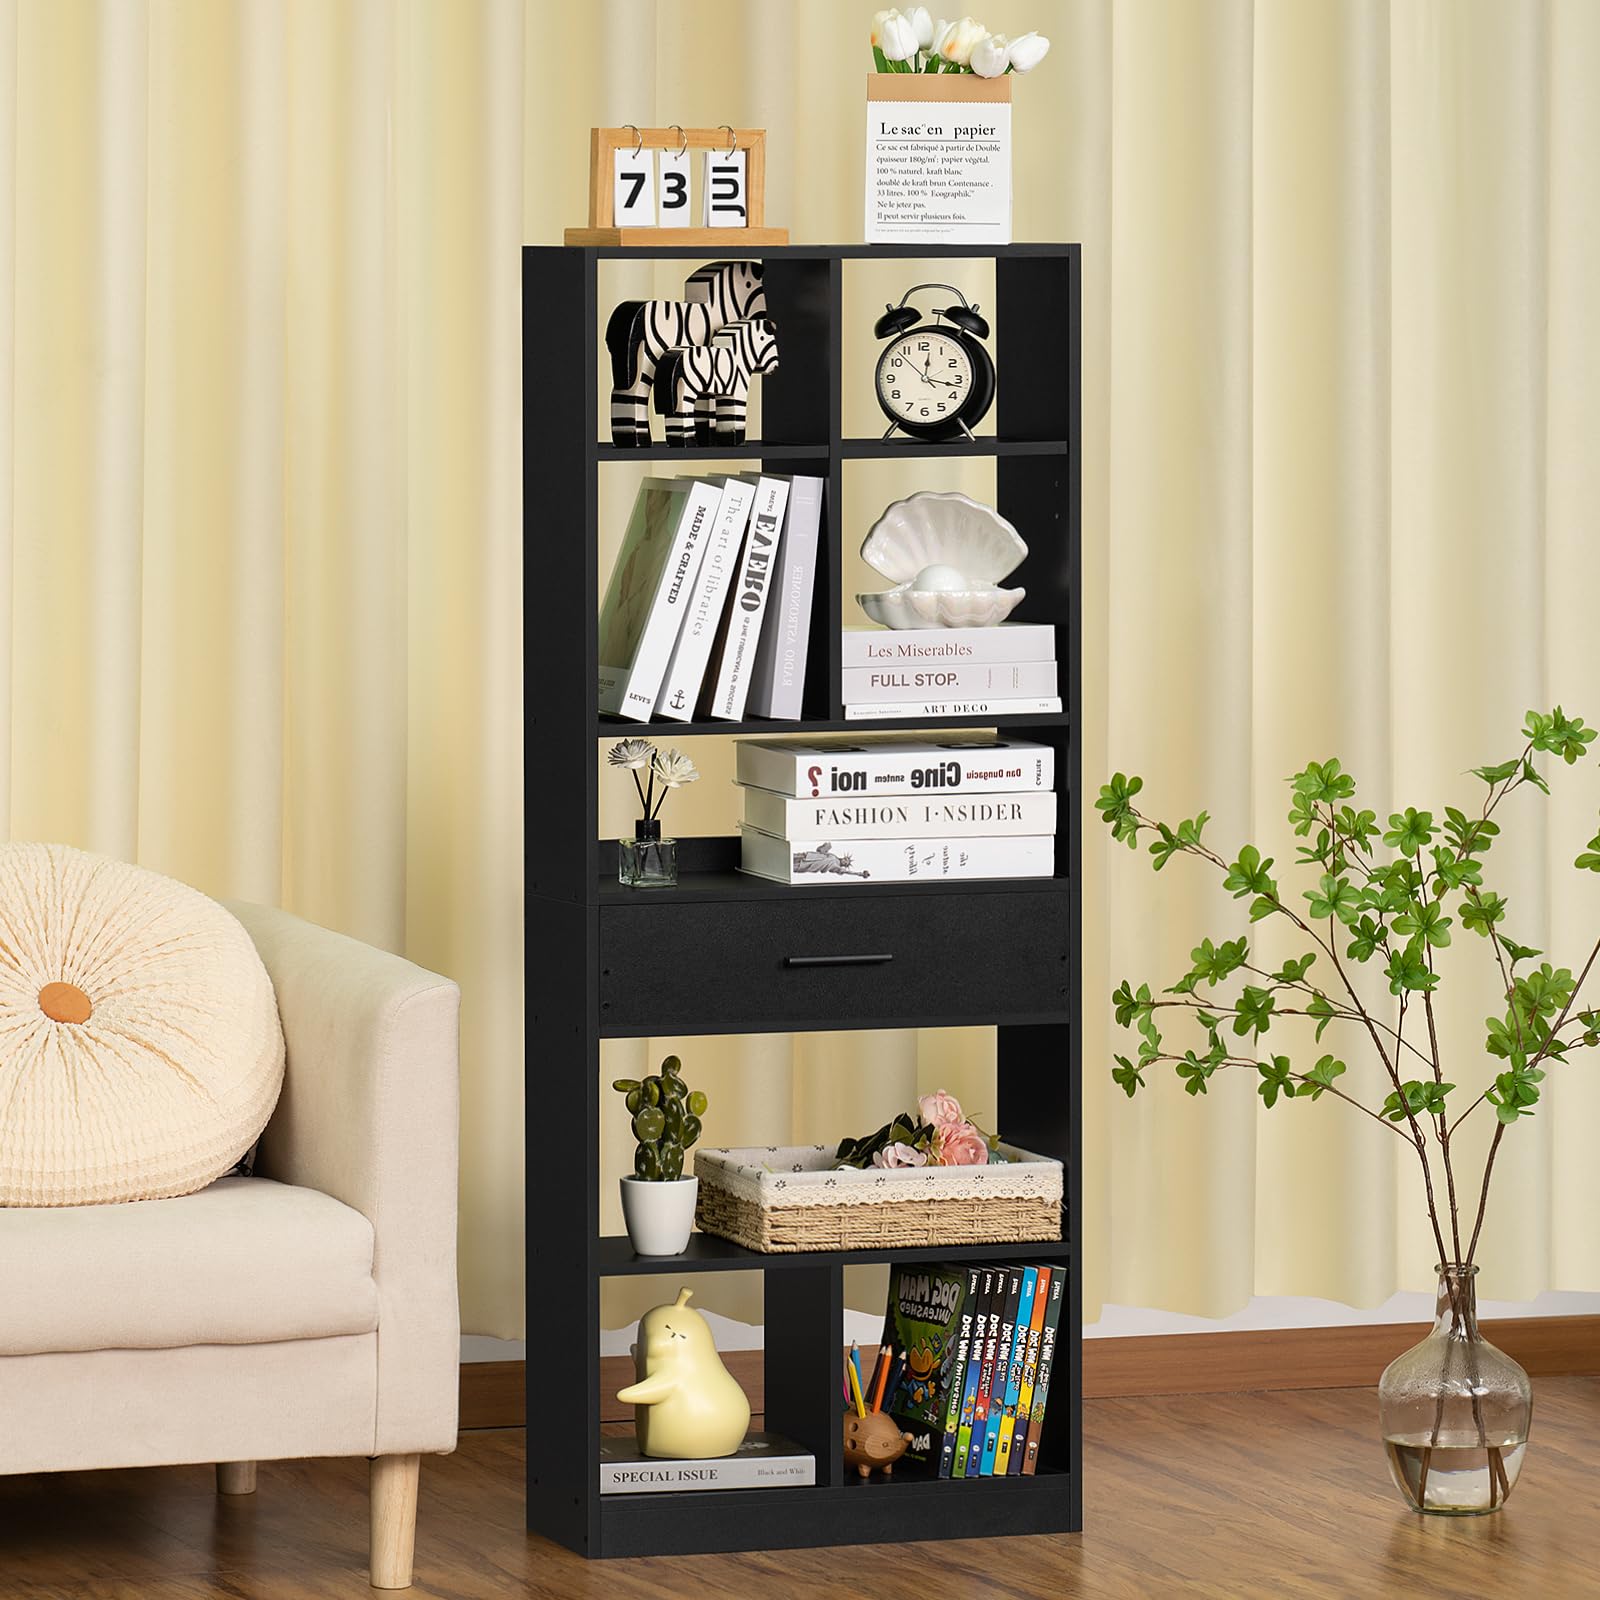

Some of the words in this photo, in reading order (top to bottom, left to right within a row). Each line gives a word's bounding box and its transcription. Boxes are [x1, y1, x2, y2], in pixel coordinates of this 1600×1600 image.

[880, 122, 898, 135] Le
[927, 126, 943, 135] en
[954, 124, 996, 139] papier
[910, 144, 939, 153] fabriqué
[945, 144, 965, 153] partir
[975, 144, 1000, 152] Double
[876, 155, 907, 164] épaisseur
[941, 156, 963, 164] papier
[620, 172, 646, 208] 7
[662, 172, 688, 208] 3
[920, 212, 951, 221] plusieurs
[903, 346, 911, 355] 11
[918, 342, 930, 351] 12
[940, 346, 943, 356] 1
[891, 358, 903, 367] 10
[948, 359, 957, 368] 2
[886, 374, 896, 383] 9
[954, 375, 963, 384] 3
[892, 390, 901, 399] 8
[948, 391, 958, 400] 4
[905, 402, 914, 412] 7
[920, 407, 929, 417] 6
[937, 402, 946, 412] 5
[726, 497, 743, 523] The
[688, 505, 706, 540] MADE
[718, 529, 730, 549] art
[685, 541, 694, 550] &
[712, 555, 723, 573] of
[667, 552, 690, 604] CRAFTED
[692, 574, 720, 636] libraries
[868, 644, 893, 658] Les
[897, 643, 973, 657] Miserables
[870, 674, 910, 687] FULL
[914, 673, 960, 686] STOP.
[922, 705, 948, 714] ART
[954, 704, 988, 713] DECO
[816, 806, 908, 825] FASHION
[613, 1471, 674, 1483] SPECIAL
[678, 1469, 718, 1481] ISSUE
